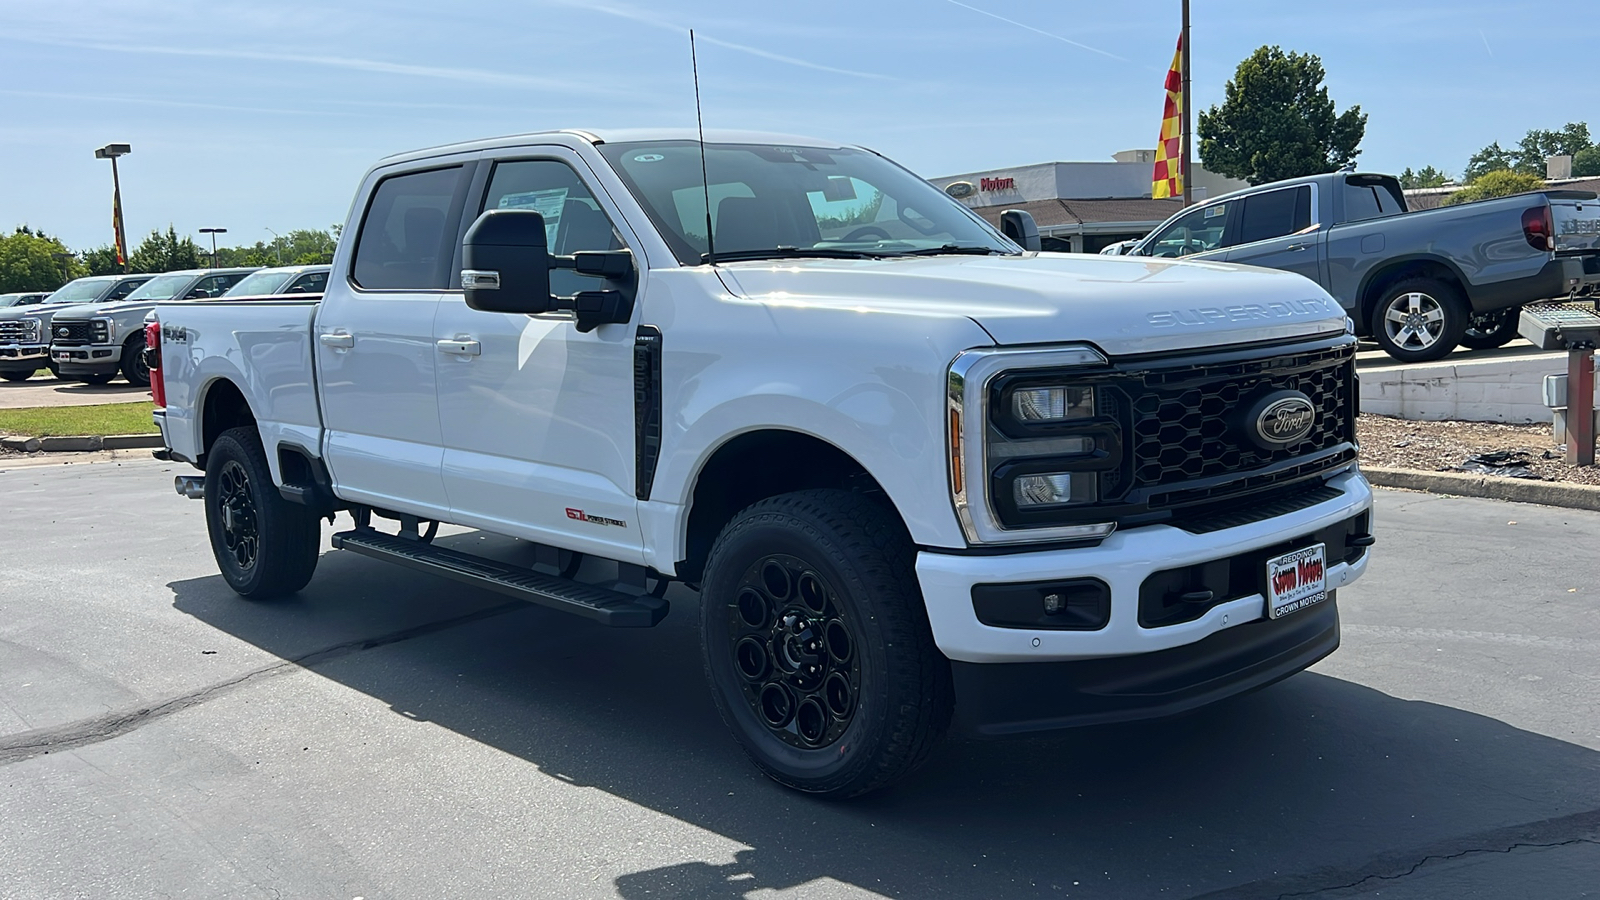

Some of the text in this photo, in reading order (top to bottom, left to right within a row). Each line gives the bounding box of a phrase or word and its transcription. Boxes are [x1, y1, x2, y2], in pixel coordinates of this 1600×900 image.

[981, 177, 1013, 192] Motors
[1146, 298, 1330, 328] SUPER DUTY
[1274, 407, 1305, 433] Ford
[588, 515, 604, 523] POWER
[1282, 549, 1313, 564] REDDING
[1272, 557, 1323, 595] Crown Motors
[1276, 592, 1325, 616] CROWN MOTORS
